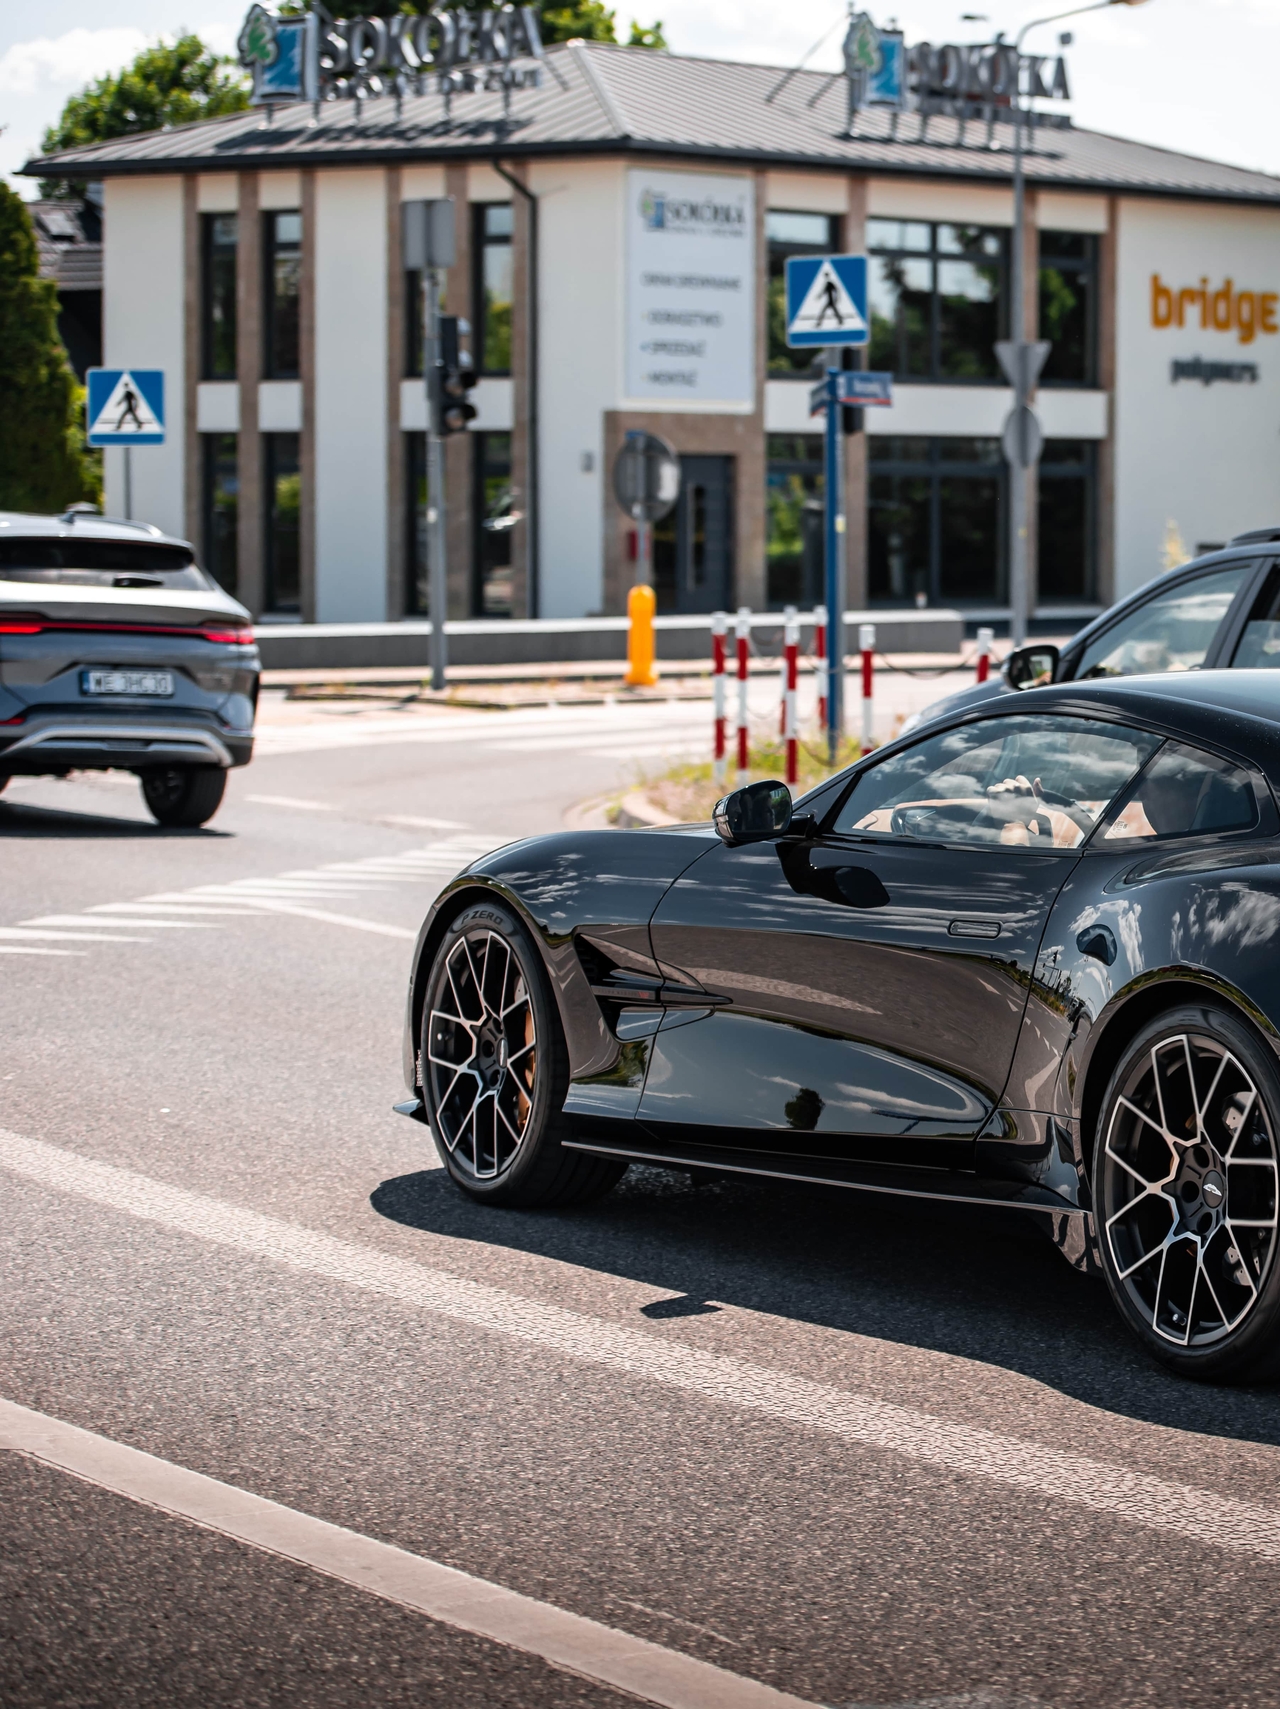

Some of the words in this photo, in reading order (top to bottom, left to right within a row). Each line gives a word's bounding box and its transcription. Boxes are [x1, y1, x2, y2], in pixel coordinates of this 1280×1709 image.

[1151, 274, 1280, 345] bridge
[461, 913, 470, 925] P
[470, 910, 504, 925] ZERO
